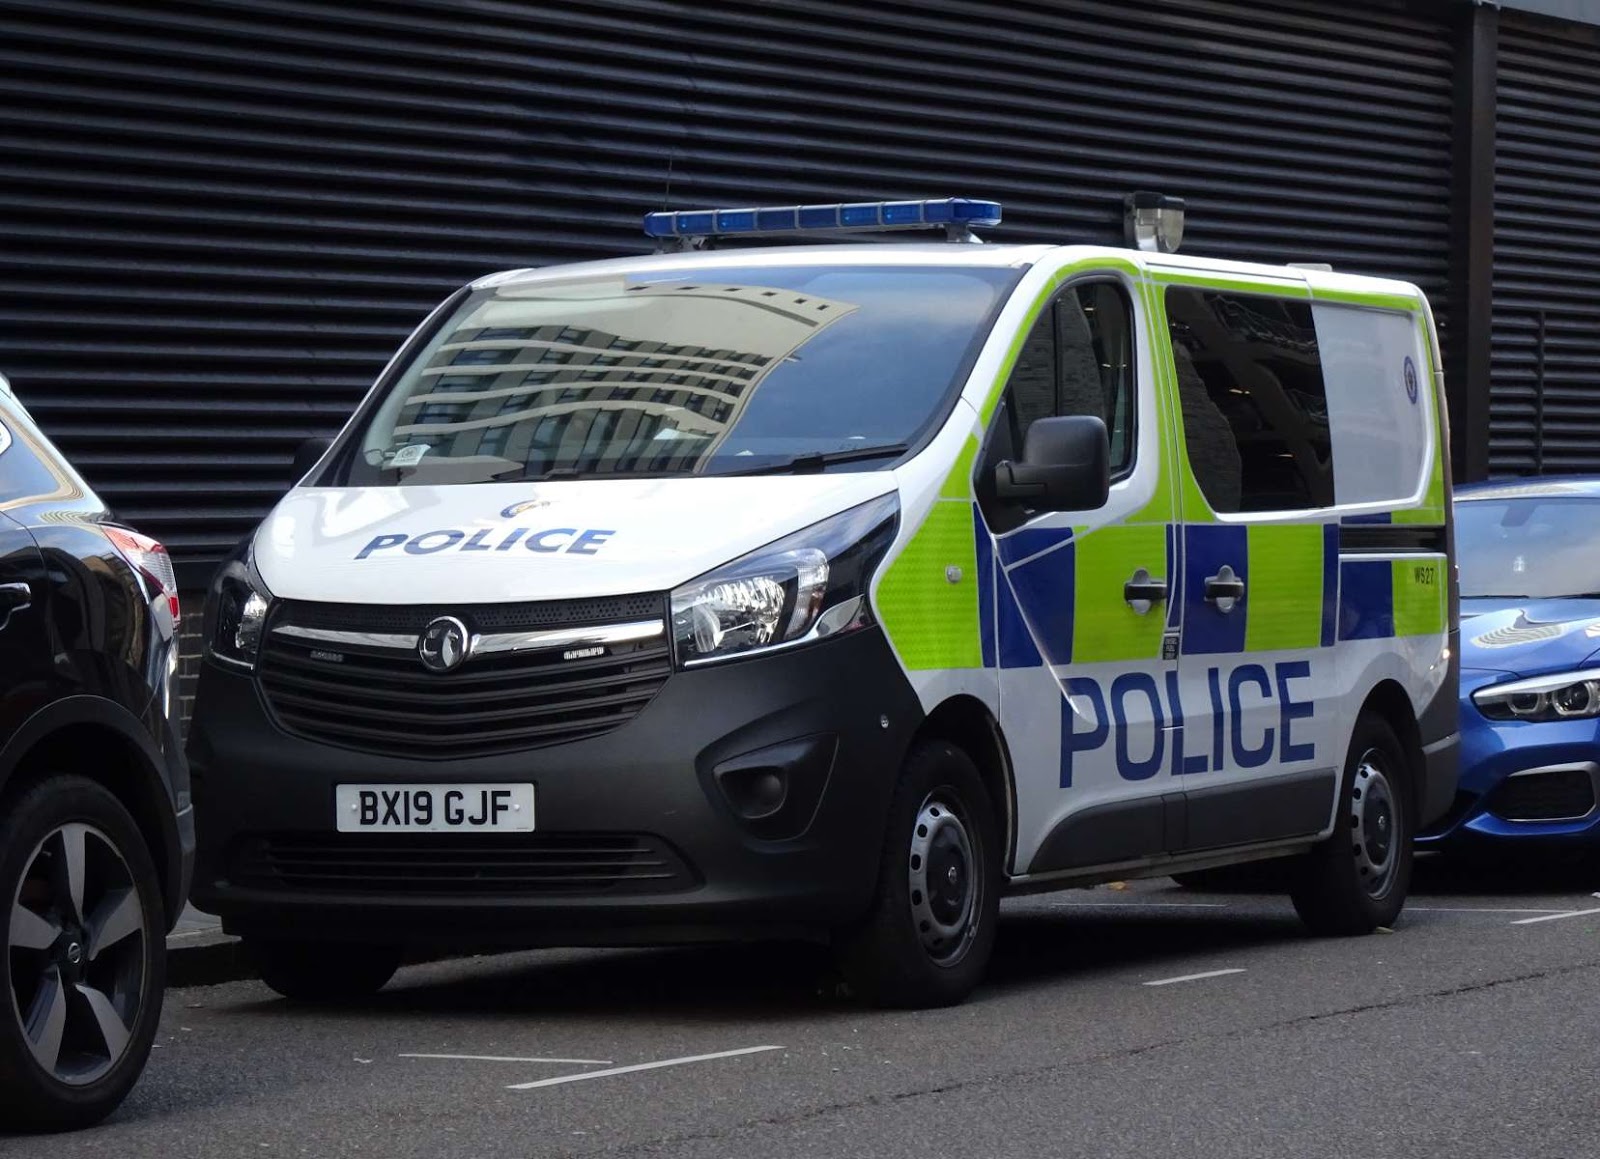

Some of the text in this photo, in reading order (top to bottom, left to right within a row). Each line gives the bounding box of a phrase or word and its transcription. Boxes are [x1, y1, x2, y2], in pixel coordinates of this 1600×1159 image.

[353, 527, 617, 560] POLICE
[1059, 660, 1315, 788] POLICE
[359, 790, 511, 826] BX19 GJF
